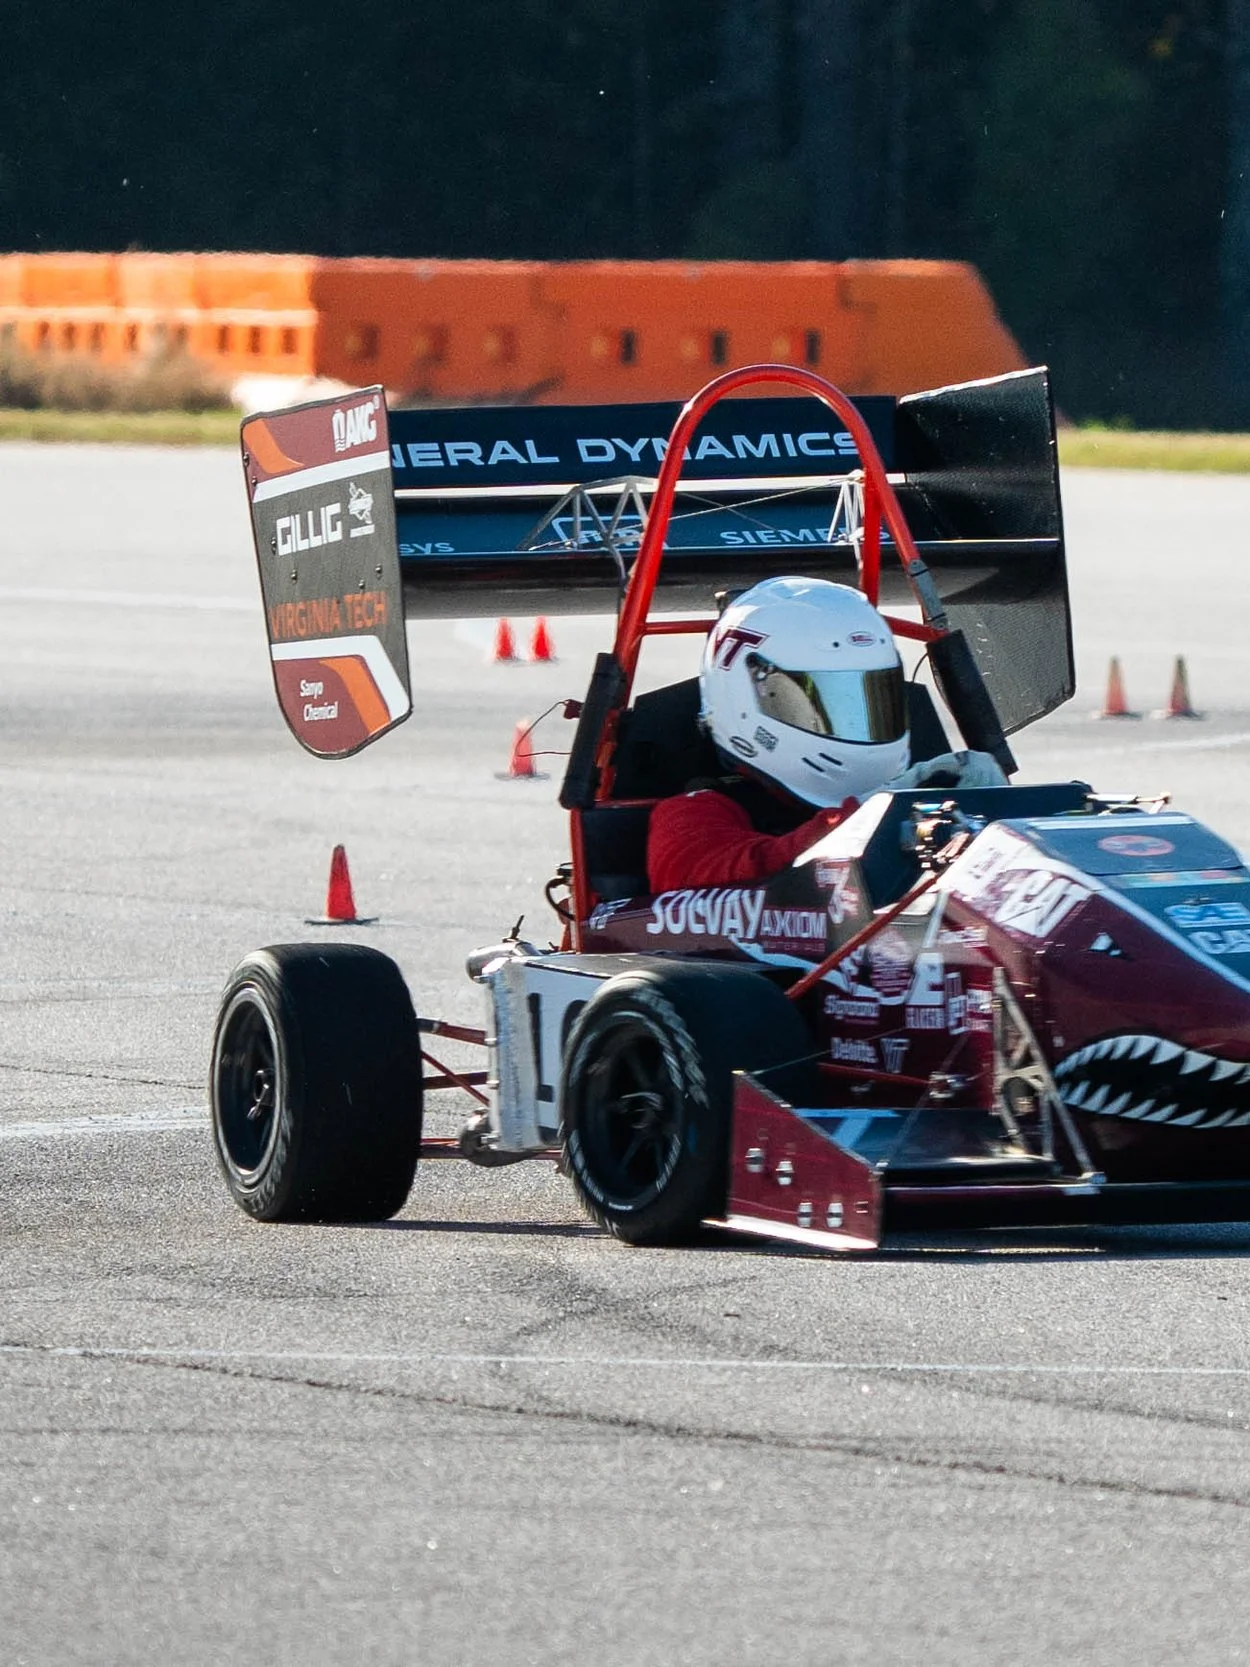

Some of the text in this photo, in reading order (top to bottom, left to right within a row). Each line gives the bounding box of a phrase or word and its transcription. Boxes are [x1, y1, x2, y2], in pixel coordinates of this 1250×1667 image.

[391, 439, 560, 468] ERAL
[276, 502, 343, 556] GILLIG
[719, 526, 891, 545] SIEMES
[269, 591, 387, 639] VIRGINIA TECH
[646, 887, 767, 939] SOLVAY
[760, 909, 827, 939] AXIOM
